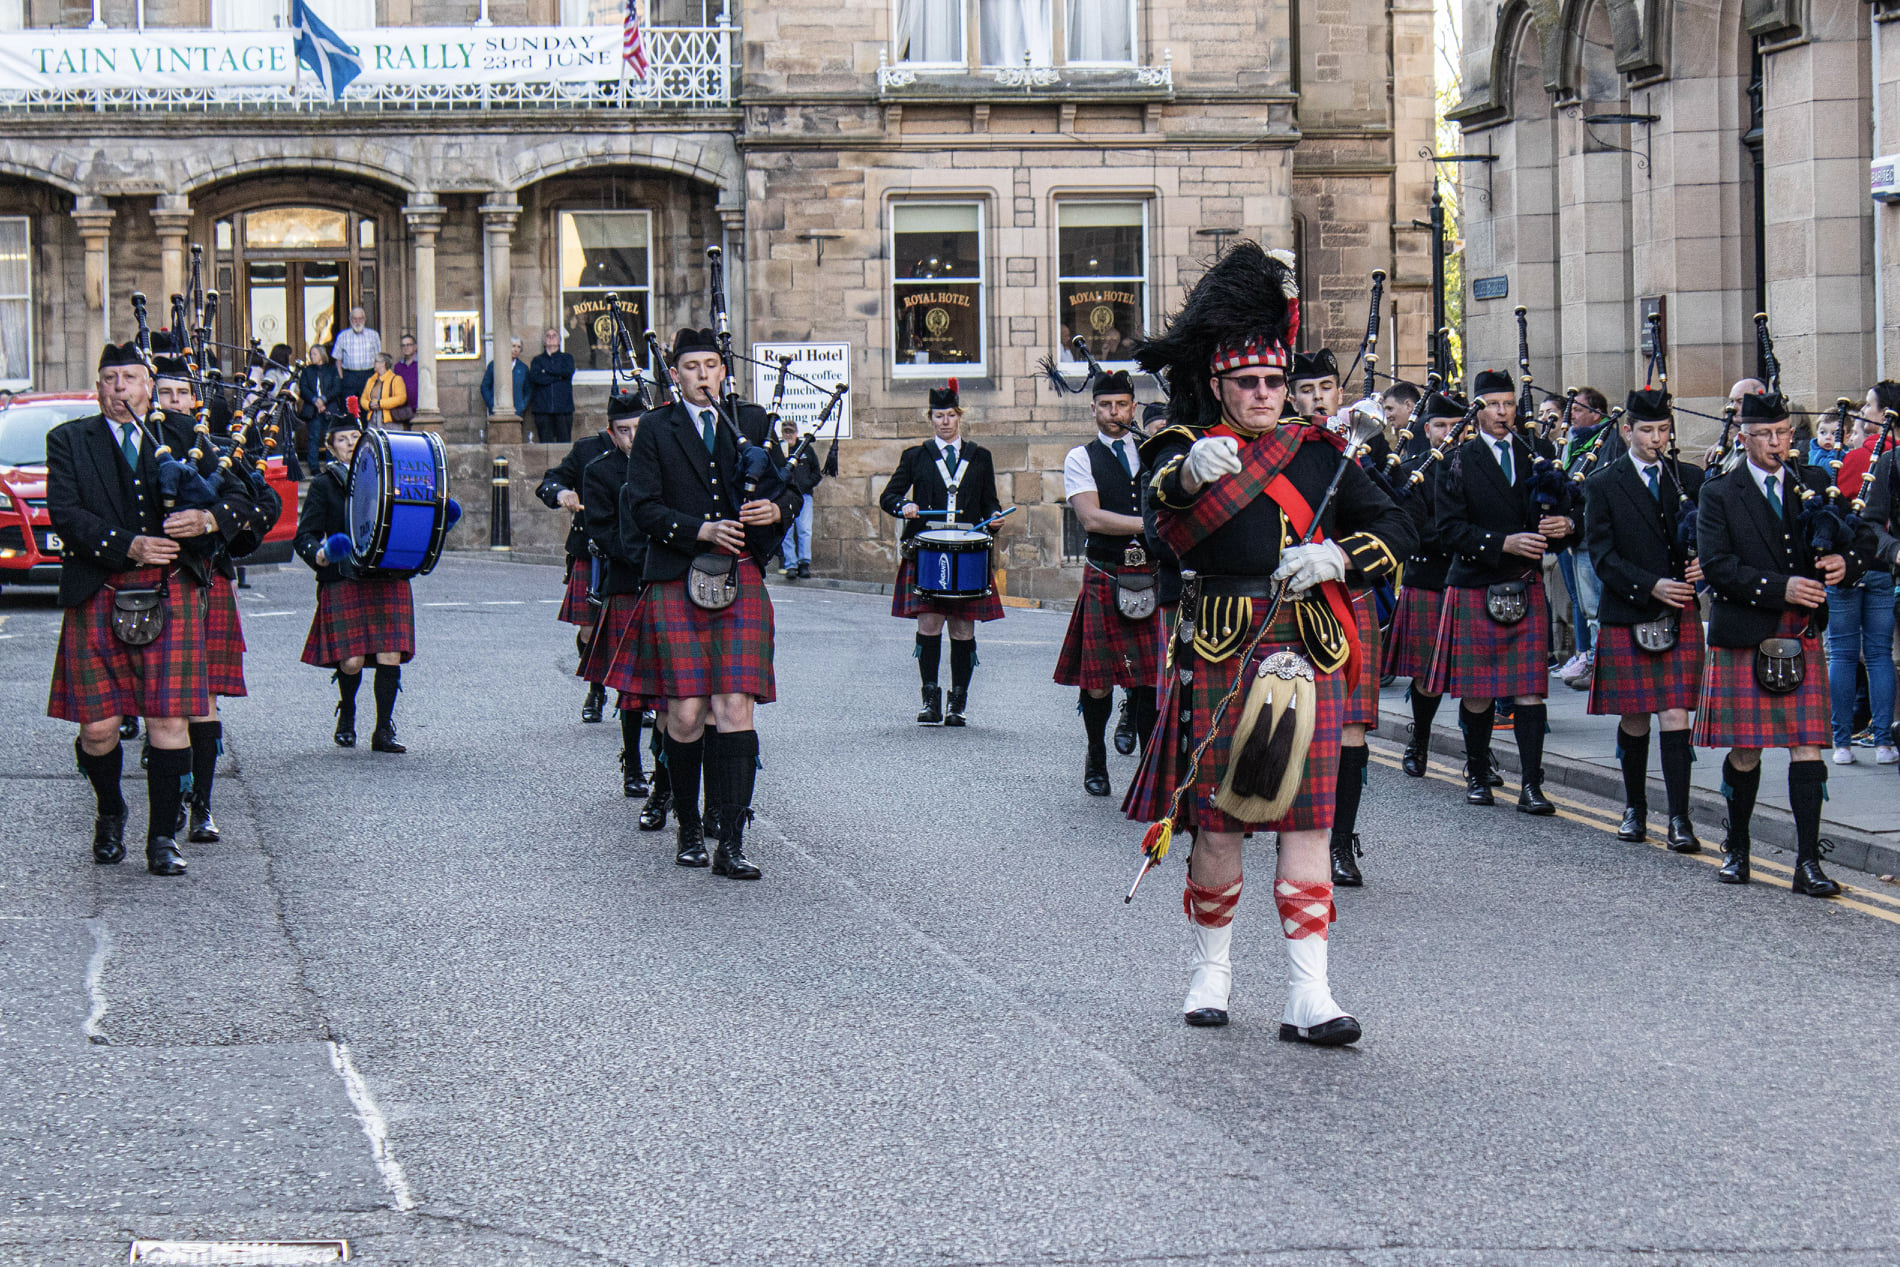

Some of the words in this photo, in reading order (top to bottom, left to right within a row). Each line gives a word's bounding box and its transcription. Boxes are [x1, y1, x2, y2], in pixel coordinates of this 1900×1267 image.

[485, 35, 594, 51] SUNDAY
[32, 47, 117, 73] TAIN
[129, 46, 287, 72] VINTAGE
[373, 42, 476, 70] RALLY
[483, 55, 532, 70] 23rd
[545, 51, 612, 70] JUNE
[904, 292, 937, 308] ROYAL
[938, 292, 971, 308] HOTEL
[1069, 290, 1102, 306] ROYAL
[1103, 290, 1135, 305] HOTEL
[573, 300, 606, 316] ROYAL
[807, 349, 842, 361] Hotel
[811, 369, 842, 380] coffee
[765, 401, 816, 411] aernoon
[395, 459, 433, 473] TAIN
